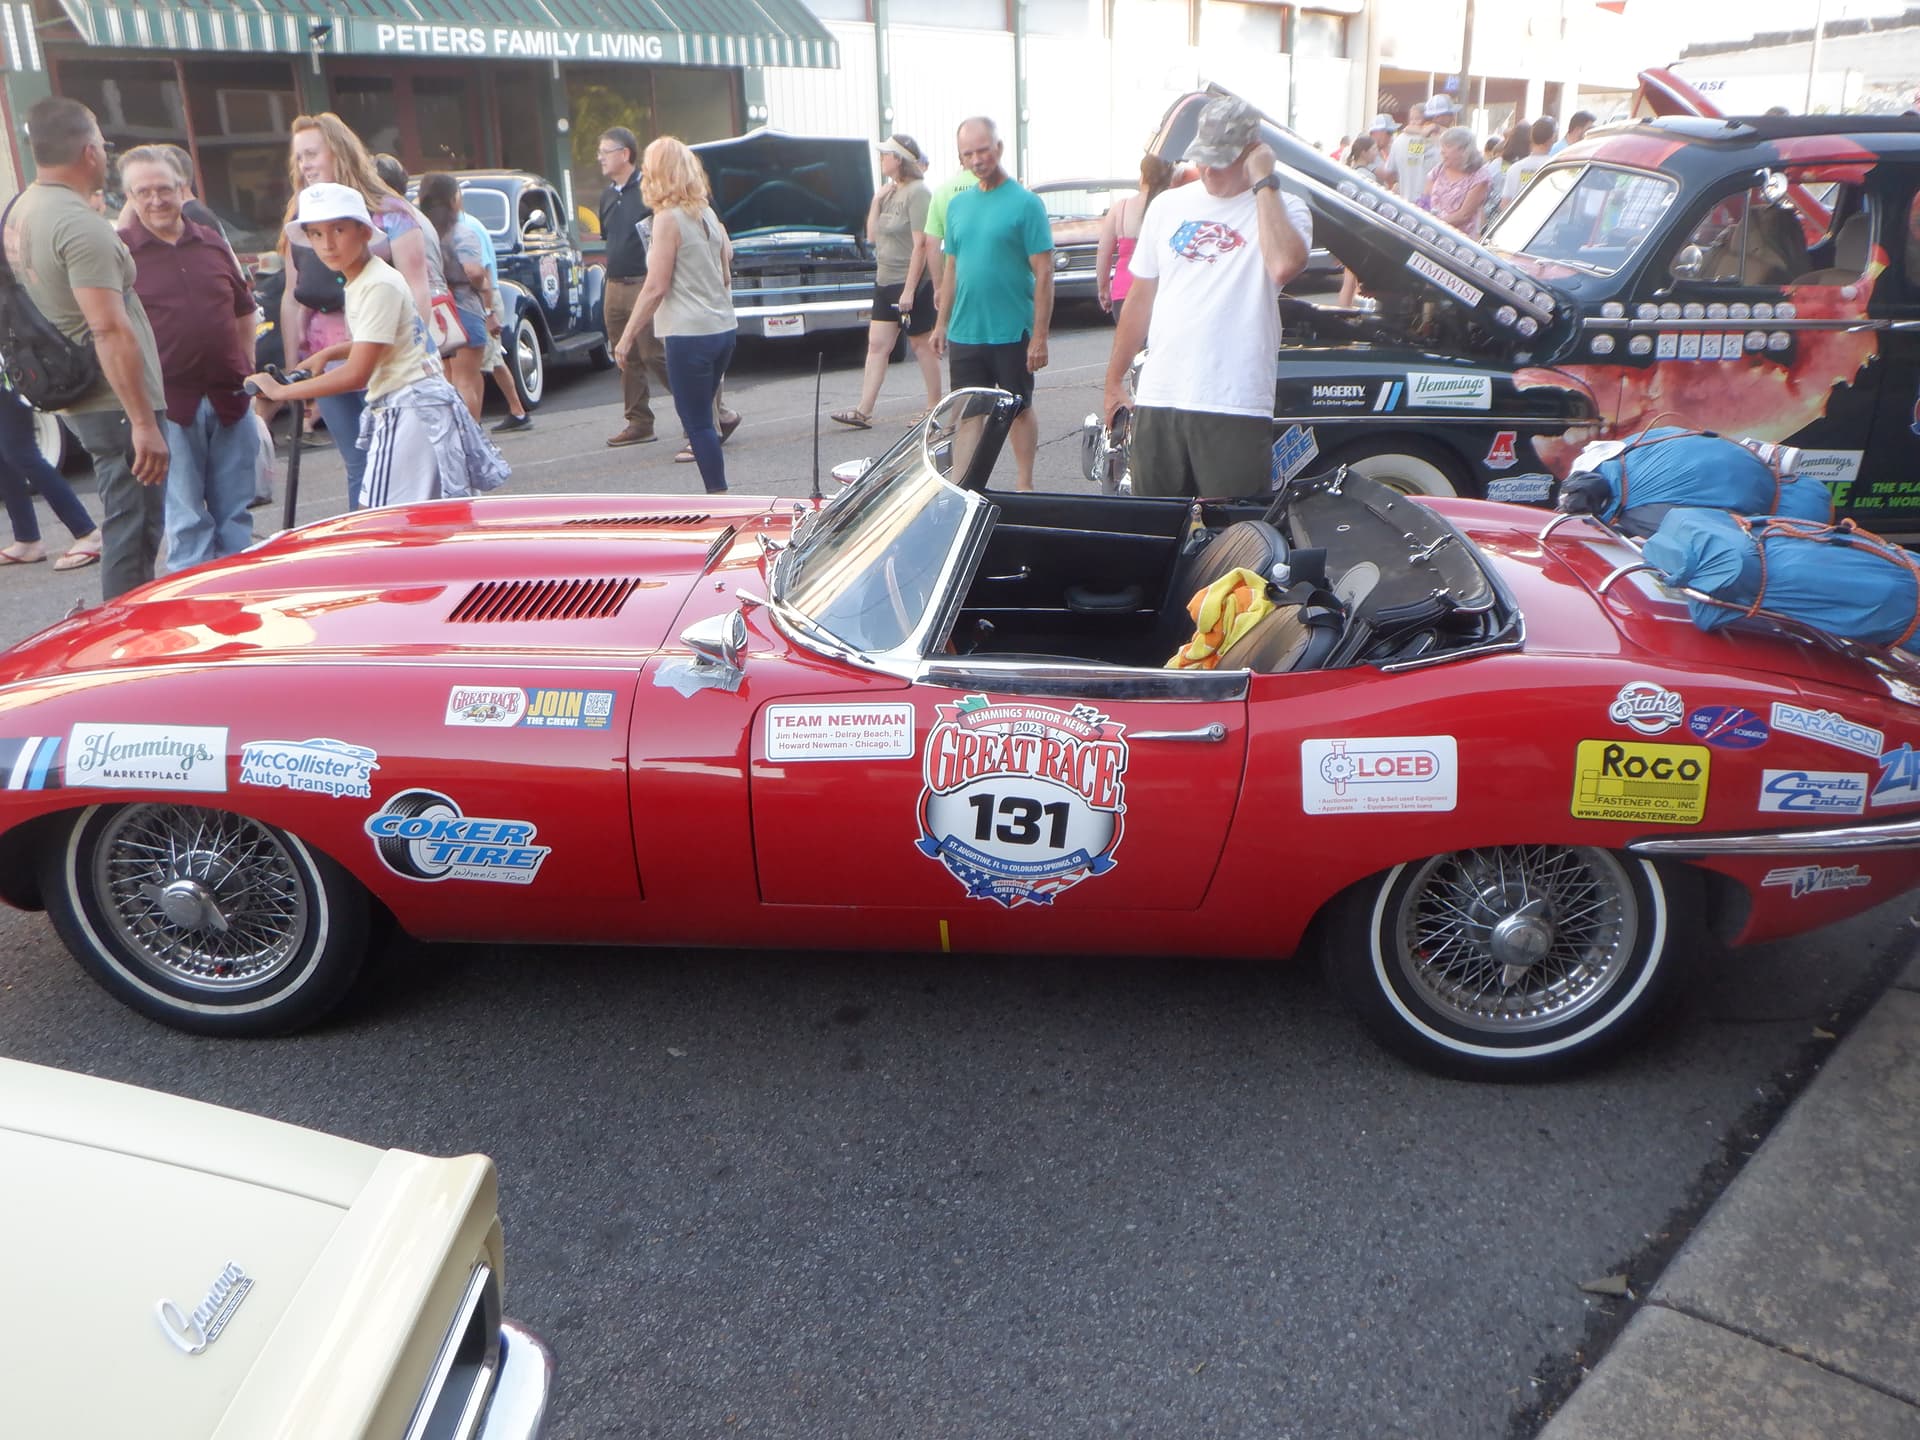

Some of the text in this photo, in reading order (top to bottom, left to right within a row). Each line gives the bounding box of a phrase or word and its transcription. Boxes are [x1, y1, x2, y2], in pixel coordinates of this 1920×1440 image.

[376, 24, 663, 58] PETERS FAMILY LIVING
[1411, 252, 1482, 304] TIMEWISE
[1312, 385, 1366, 397] HAGERTY
[1415, 375, 1485, 394] Hemmings
[1872, 482, 1896, 493] THE
[1854, 497, 1886, 508] LIVE,
[452, 691, 521, 713] GREAT RACE
[528, 690, 583, 717] JOIN
[526, 717, 544, 725] THE
[546, 717, 579, 727] CREW!
[774, 714, 906, 727] TEAM NEWMAN
[967, 708, 1092, 737] HEMMINGS MOTOR NEWS
[1014, 722, 1044, 735] 2023
[1691, 722, 1708, 730] FORD
[1694, 714, 1712, 722] EARLY
[1779, 709, 1878, 746] PARAGON
[776, 731, 791, 739] Jim
[792, 732, 828, 740] Newman
[835, 730, 861, 740] Delray
[863, 730, 892, 739] Beach,
[894, 730, 905, 738] FL
[779, 742, 811, 750] Howard
[812, 740, 848, 749] Newman
[855, 740, 892, 750] Chicago,
[893, 740, 902, 748] IL
[78, 731, 214, 771] Hemmings
[103, 769, 189, 780] MARKETPLACE
[243, 748, 369, 780] McCollister's
[929, 726, 1120, 808] GREAT RACE
[1358, 756, 1432, 777] LOEB
[242, 768, 370, 796] Auto Transport
[1765, 772, 1864, 793] Corvette
[1598, 797, 1651, 807] FASTENER
[1779, 789, 1861, 810] Central
[968, 793, 1070, 849] 131
[1577, 809, 1698, 821] www.ROGOFASTENER.com
[370, 816, 531, 846] COKER
[424, 843, 540, 869] TIRE
[948, 841, 958, 850] ST.
[958, 847, 992, 867] AUGUSTINE,
[992, 861, 1000, 869] FL
[1009, 864, 1043, 872] COLORADO
[1043, 859, 1073, 871] SPRINGS,
[1072, 855, 1082, 864] CO
[453, 869, 531, 882] Wheels Too!
